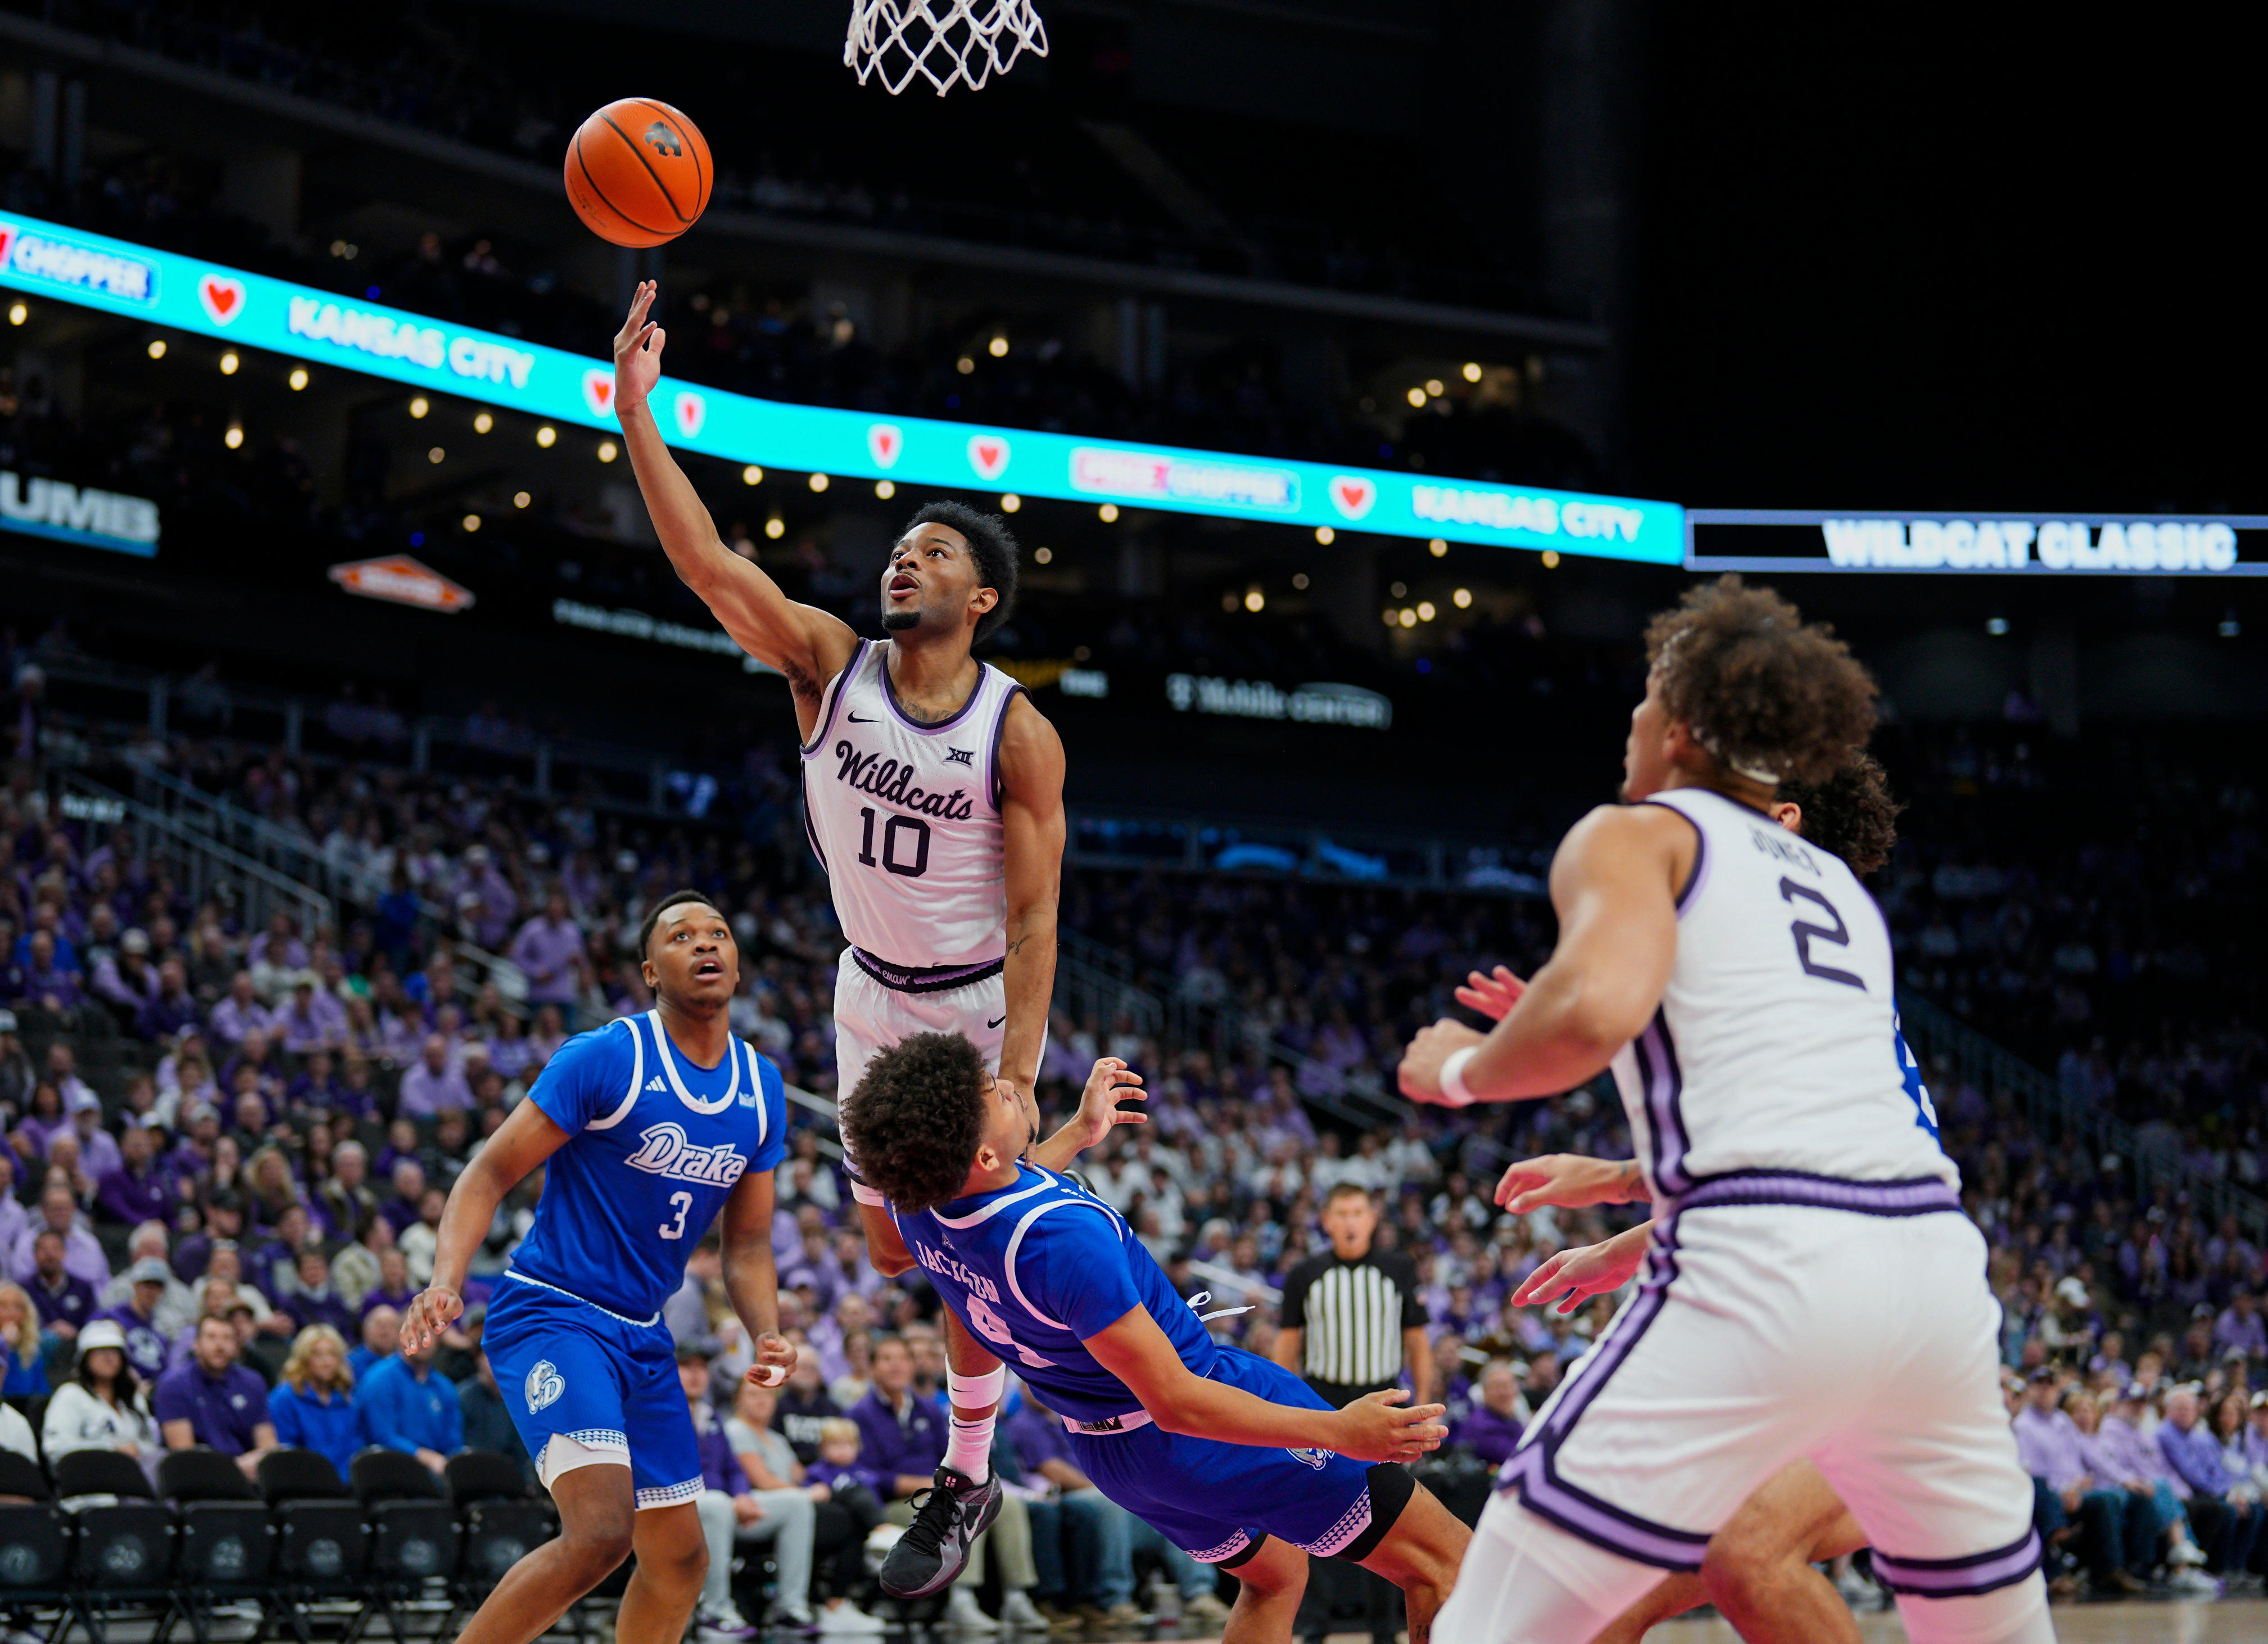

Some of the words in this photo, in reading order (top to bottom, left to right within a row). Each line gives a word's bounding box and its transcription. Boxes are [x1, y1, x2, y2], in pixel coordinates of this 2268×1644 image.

[289, 295, 446, 369] KANSAS
[450, 337, 535, 389] CITY
[0, 470, 162, 543] UMB
[1412, 484, 1560, 535] KANSAS
[1561, 502, 1644, 543] CITY
[1822, 520, 2036, 568] WILDCAT
[2037, 522, 2238, 571] CLASSIC
[835, 740, 974, 820] Wildcats
[945, 746, 974, 766] XII
[858, 807, 931, 878] 10
[1779, 875, 1868, 992] 2
[623, 1122, 748, 1188] Drake
[658, 1191, 693, 1240] 3
[915, 1240, 1002, 1306] JACKSON
[966, 1292, 1058, 1369] 4
